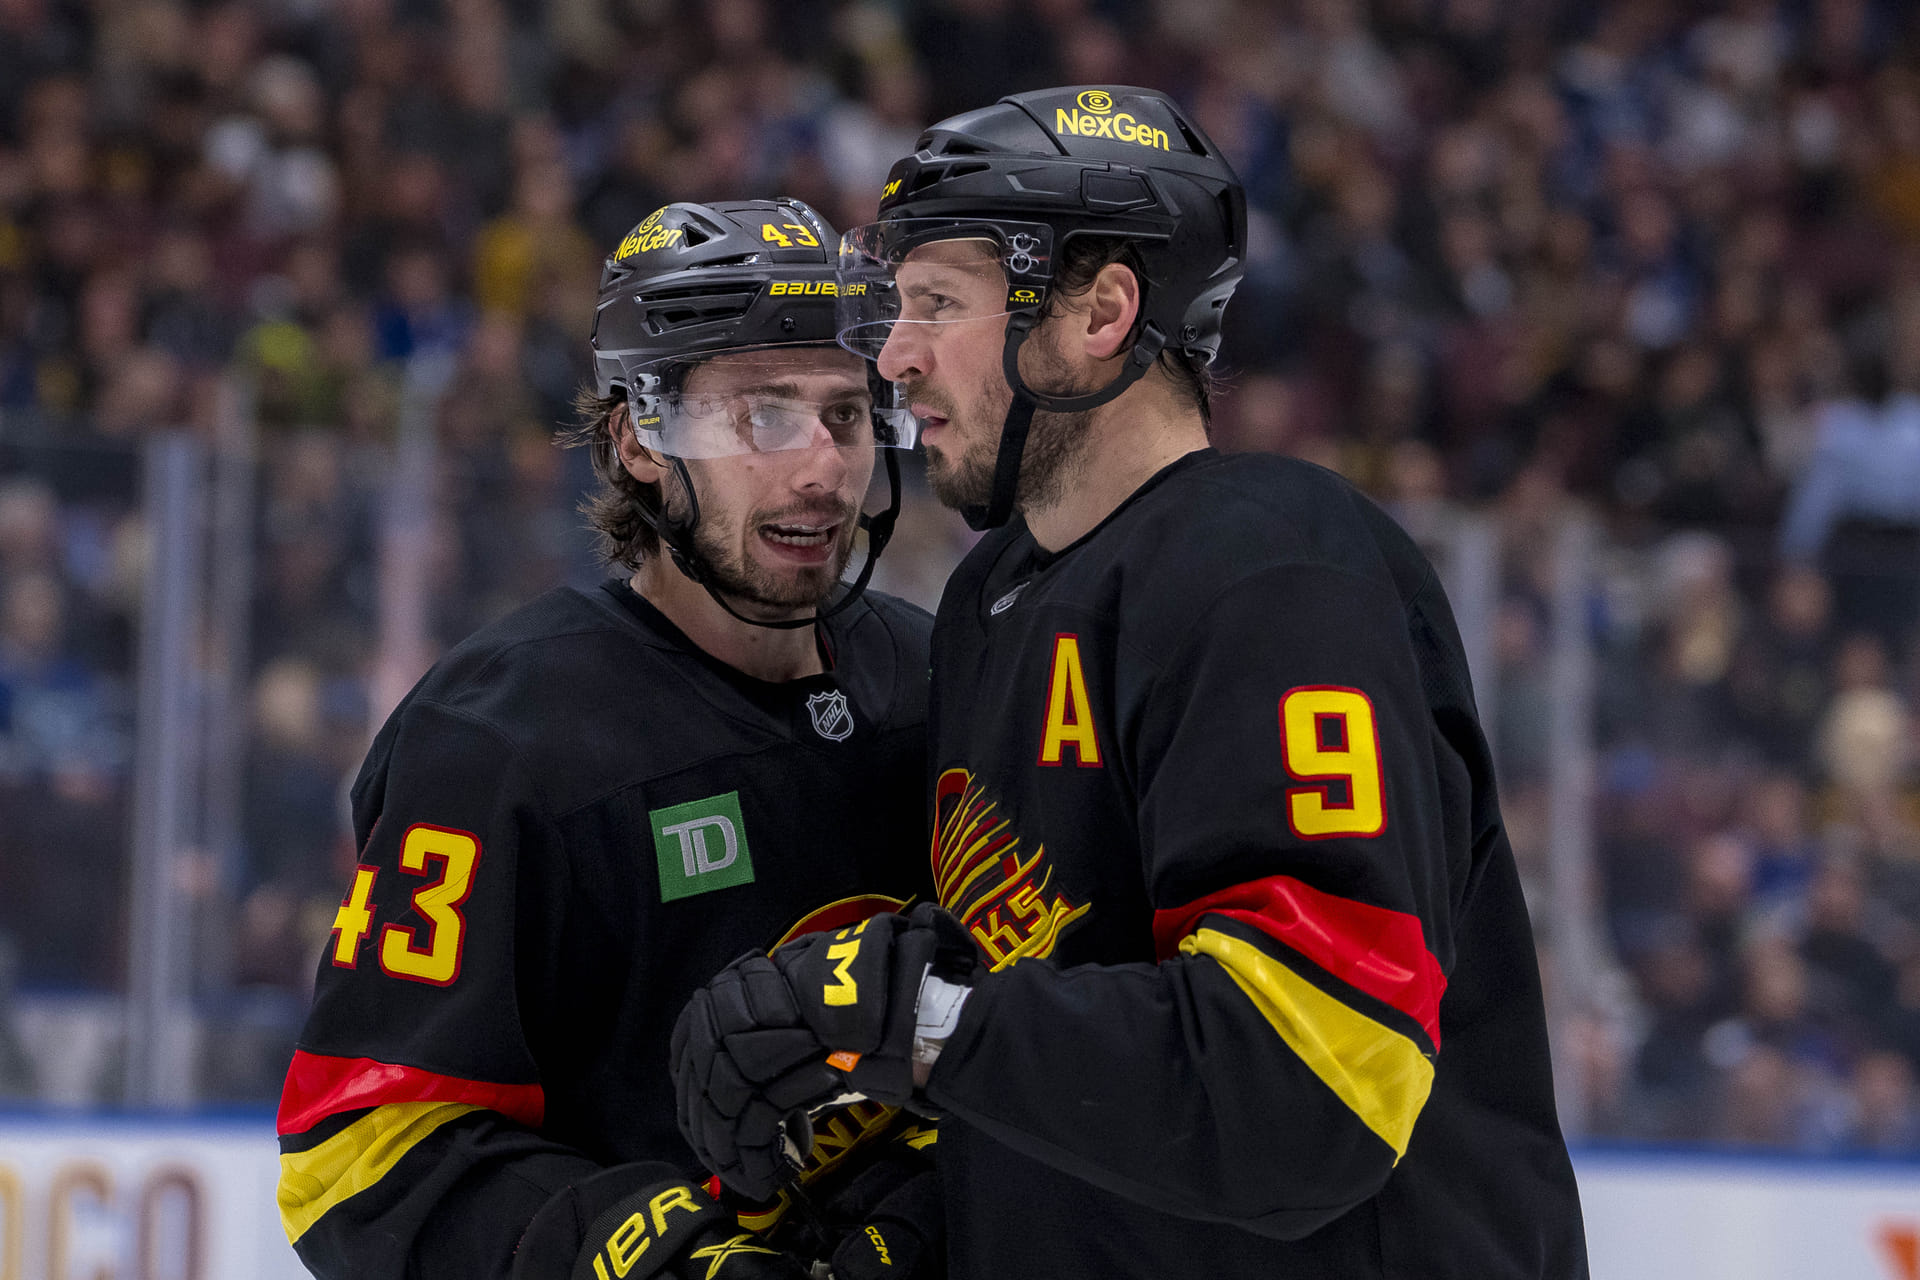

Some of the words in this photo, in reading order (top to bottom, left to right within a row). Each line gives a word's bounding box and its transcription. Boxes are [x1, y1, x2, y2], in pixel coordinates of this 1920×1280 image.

[1056, 108, 1170, 151] NexGen
[613, 224, 683, 264] NexGen
[761, 223, 820, 248] 43
[1037, 632, 1104, 769] A
[1278, 684, 1388, 841] 9
[661, 814, 738, 878] TD
[330, 822, 483, 988] 43
[864, 1225, 893, 1266] CCM
